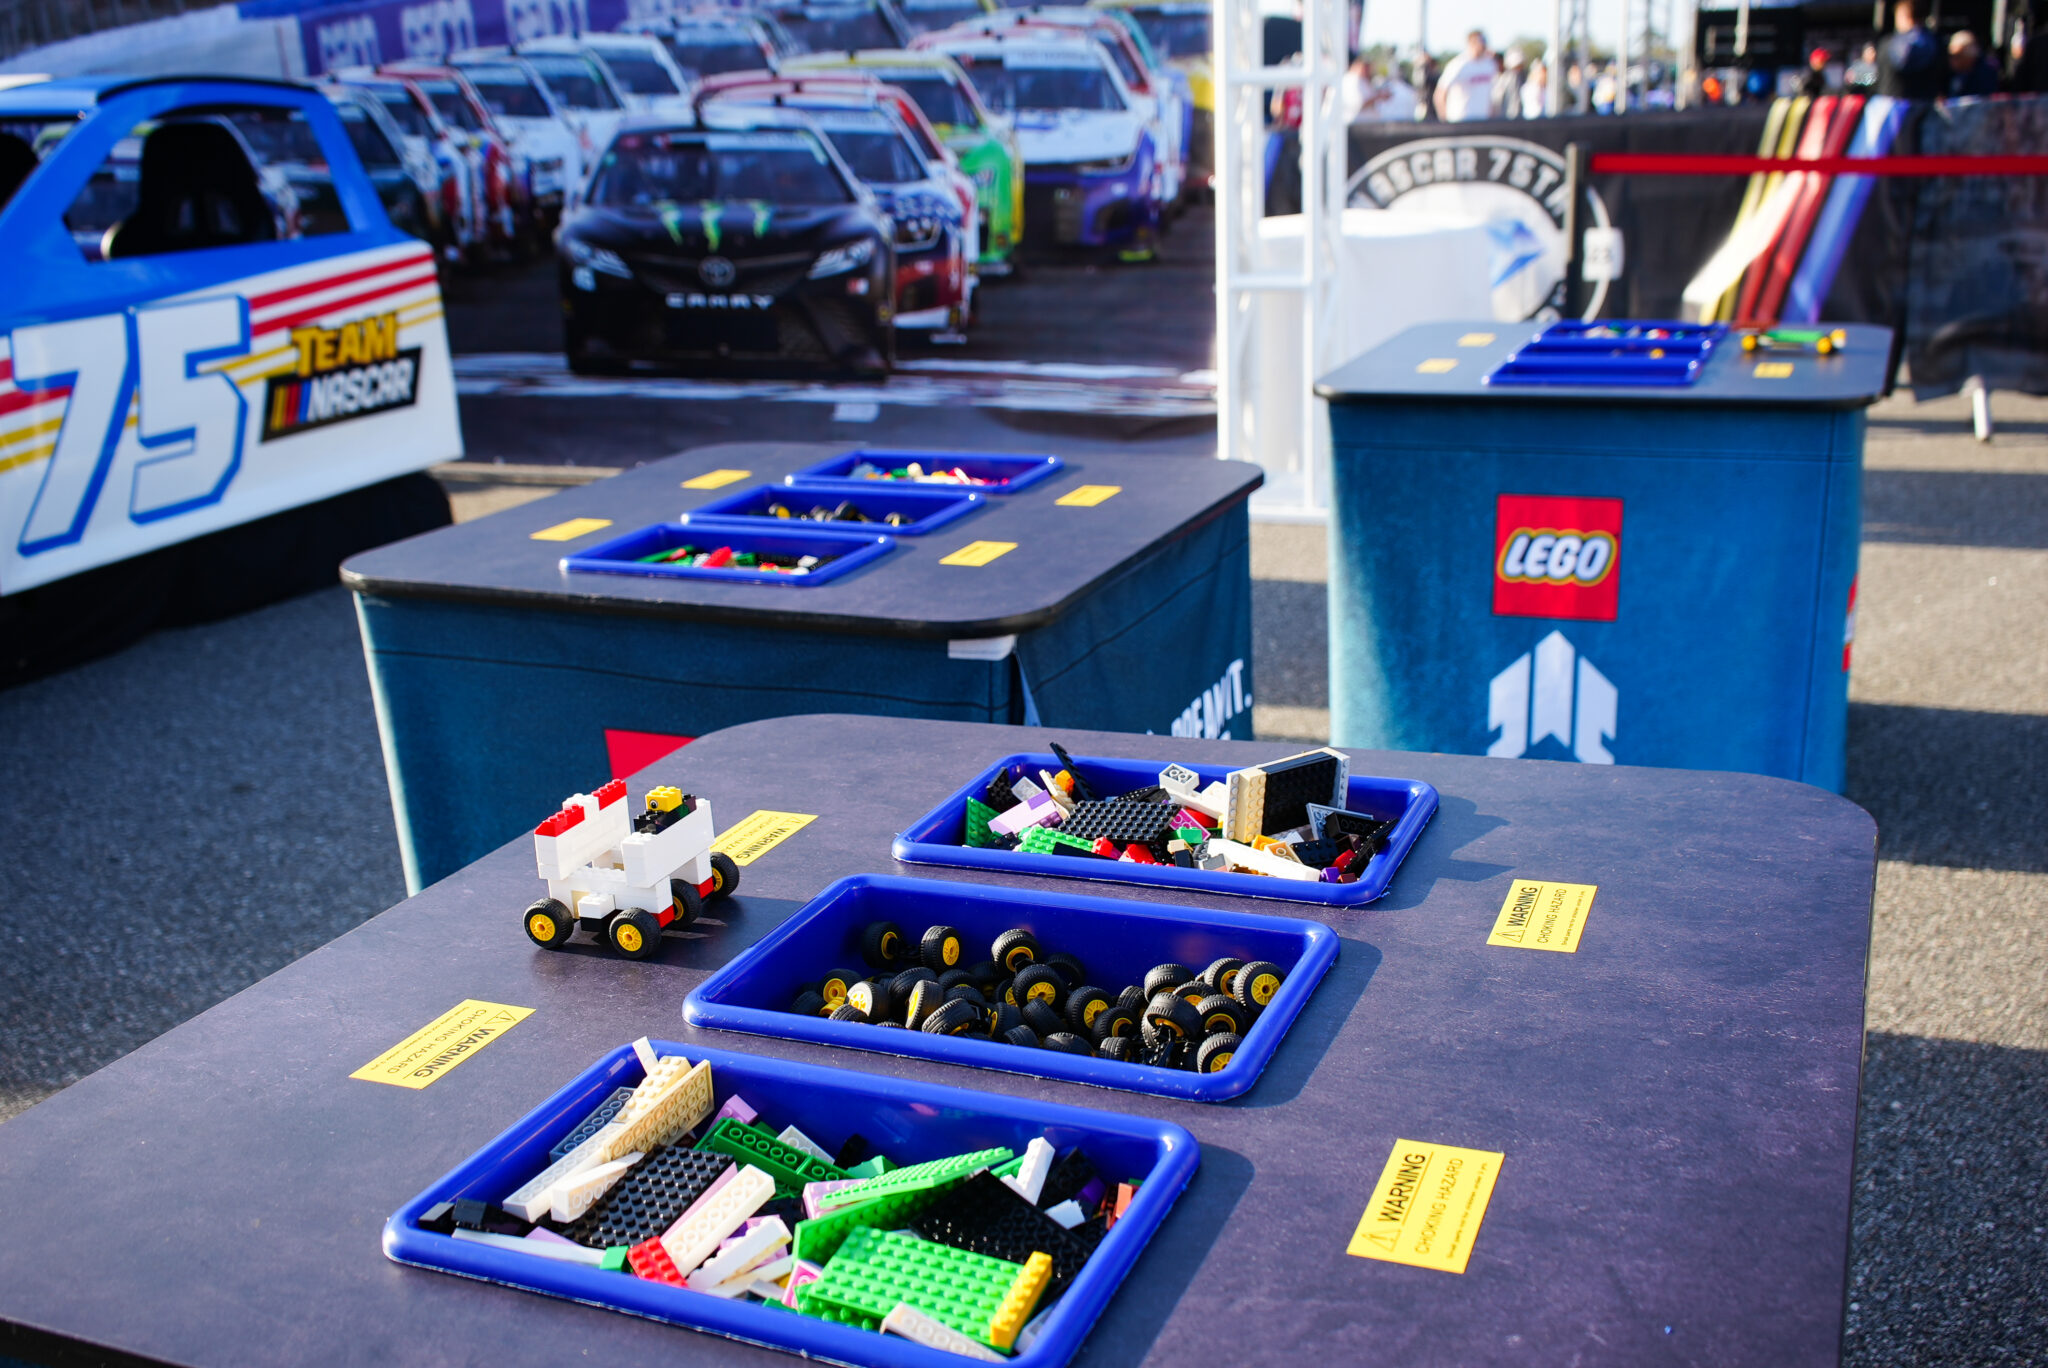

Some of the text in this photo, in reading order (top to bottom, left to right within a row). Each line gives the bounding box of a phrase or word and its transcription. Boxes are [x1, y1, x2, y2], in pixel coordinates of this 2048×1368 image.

[292, 310, 399, 377] TEAM
[306, 356, 414, 423] NASCAR
[12, 294, 251, 557] 75
[1503, 533, 1612, 581] LEGO
[735, 827, 791, 859] WARNING
[1506, 886, 1538, 927] WARNING
[1535, 888, 1567, 943] CHOKING HAZARD
[433, 1008, 489, 1041] CHOKING
[384, 1042, 439, 1073] HAZARD
[411, 1027, 496, 1078] WARNING
[1377, 1152, 1427, 1223] WARNING
[1413, 1157, 1464, 1254] CHOKING HAZARD
